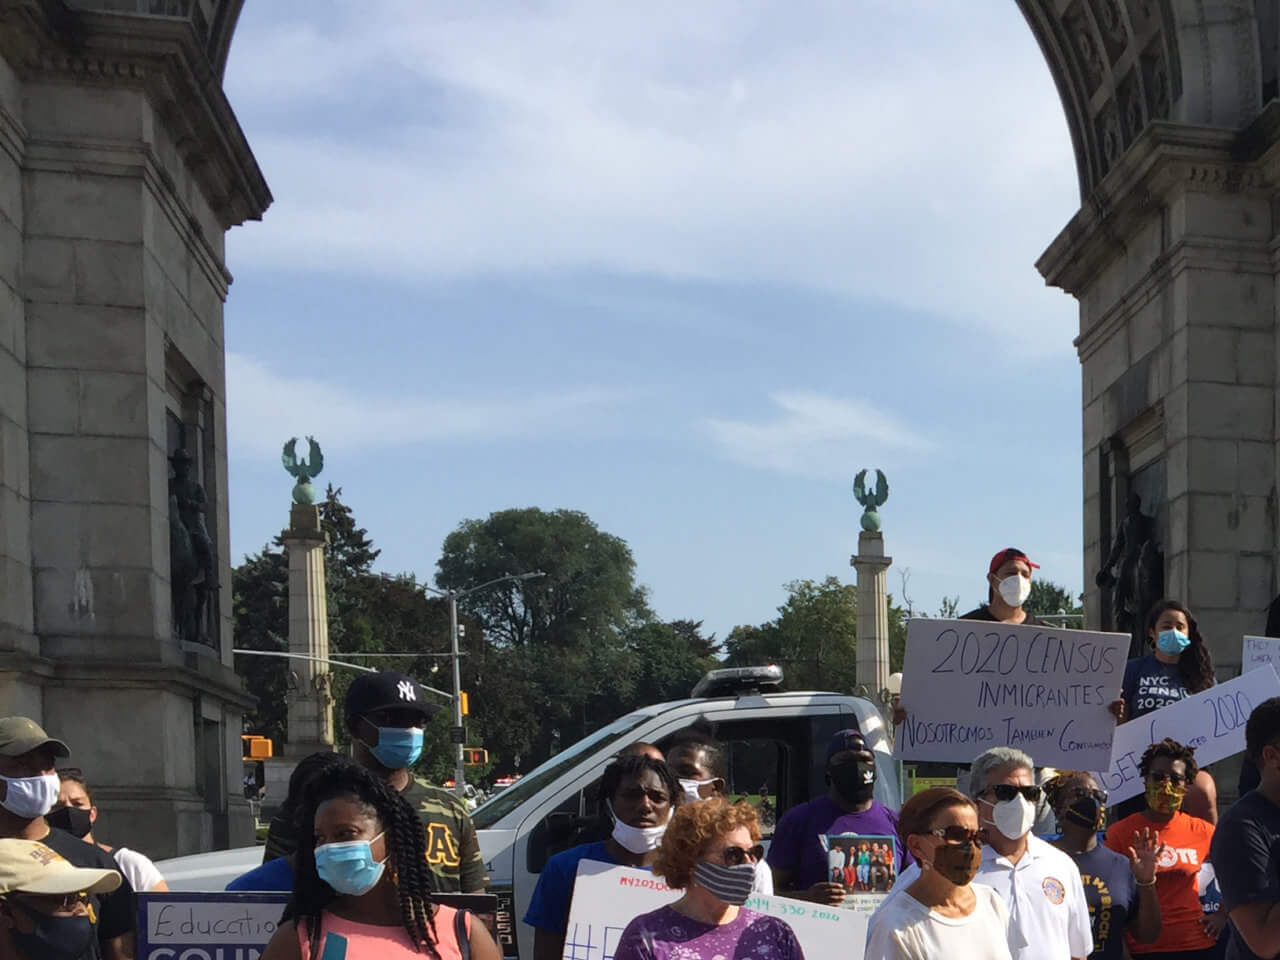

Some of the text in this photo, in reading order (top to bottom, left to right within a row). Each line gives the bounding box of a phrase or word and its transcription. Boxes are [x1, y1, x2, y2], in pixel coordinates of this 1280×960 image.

[932, 629, 1118, 675] 2020 CENSUS
[978, 680, 1105, 708] INMIGRANTES
[1139, 676, 1169, 687] NYC
[1203, 691, 1253, 738] 2020
[425, 822, 461, 866] A
[154, 904, 276, 937] Educatio
